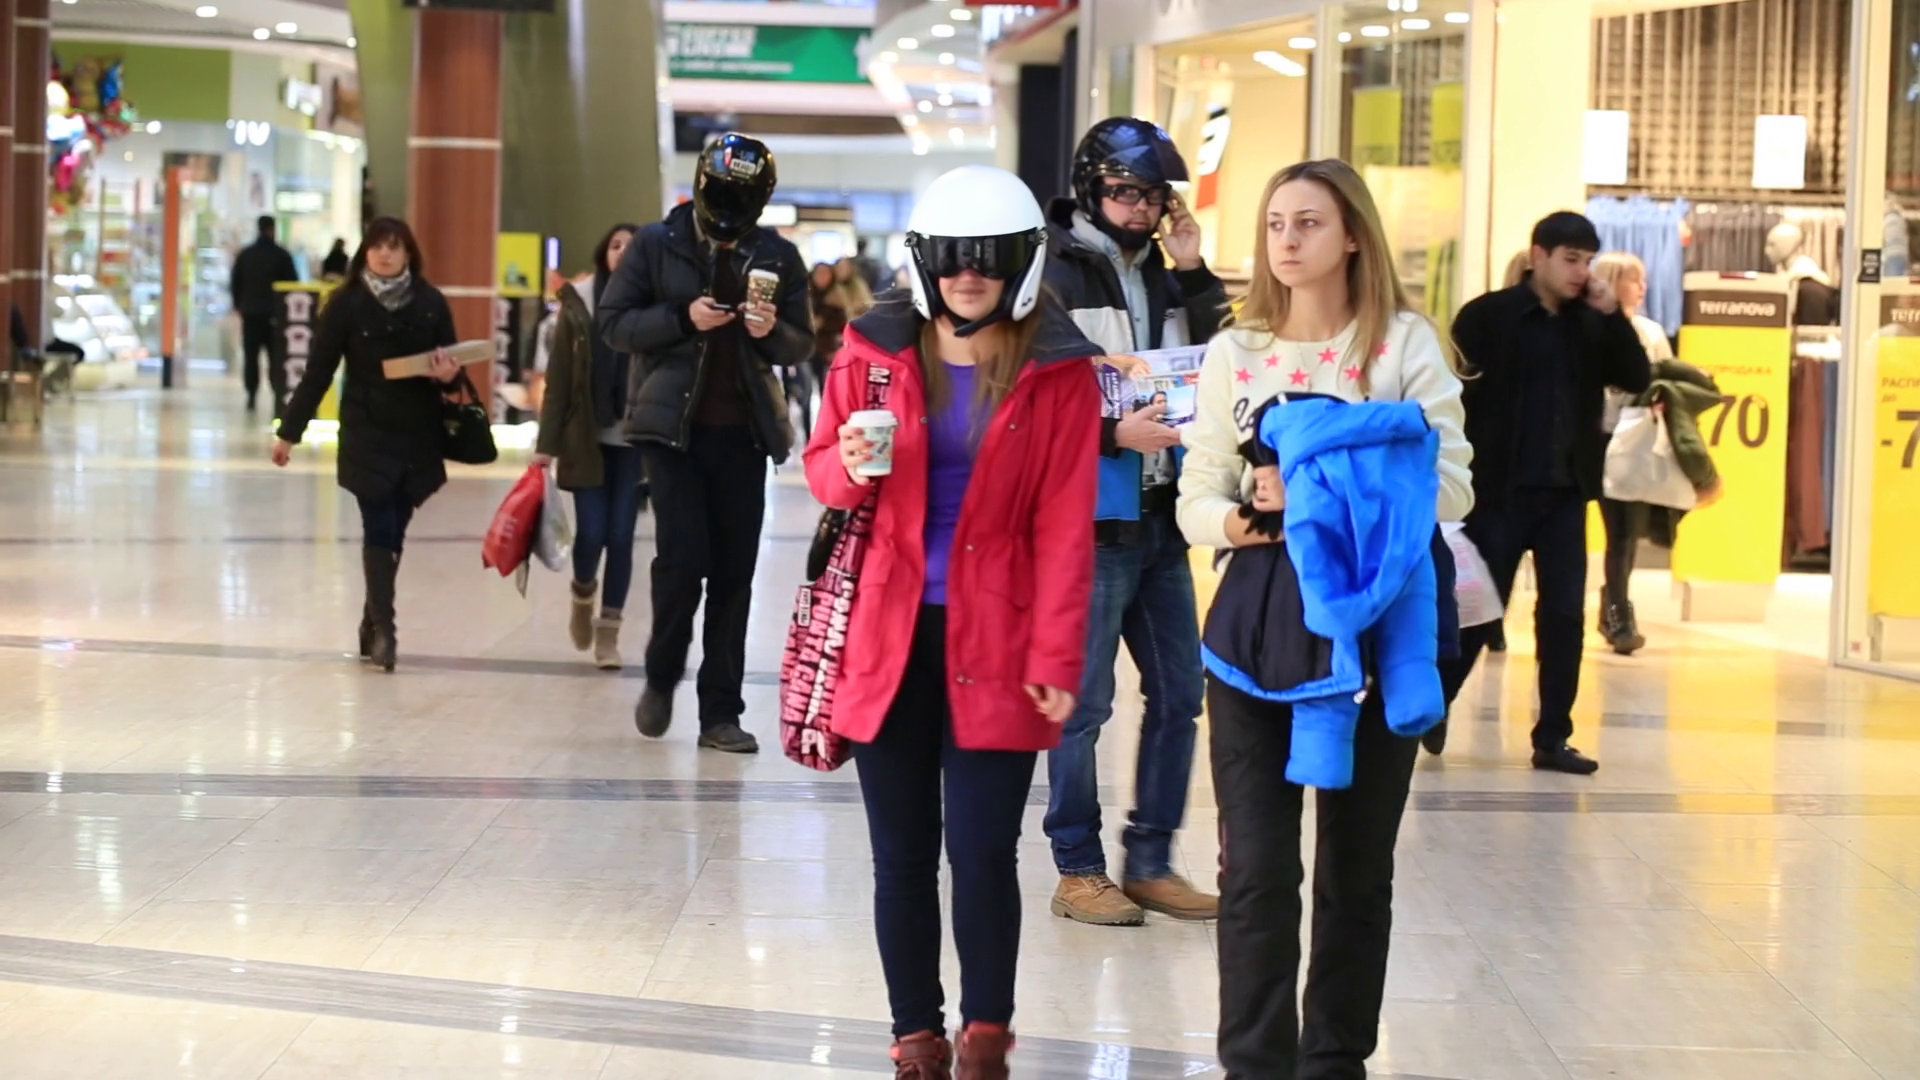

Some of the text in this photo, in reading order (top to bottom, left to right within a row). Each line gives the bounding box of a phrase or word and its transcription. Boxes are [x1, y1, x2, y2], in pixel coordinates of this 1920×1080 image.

[1699, 300, 1776, 316] terranova
[799, 590, 836, 663] PUNTA
[781, 662, 818, 727] CANA
